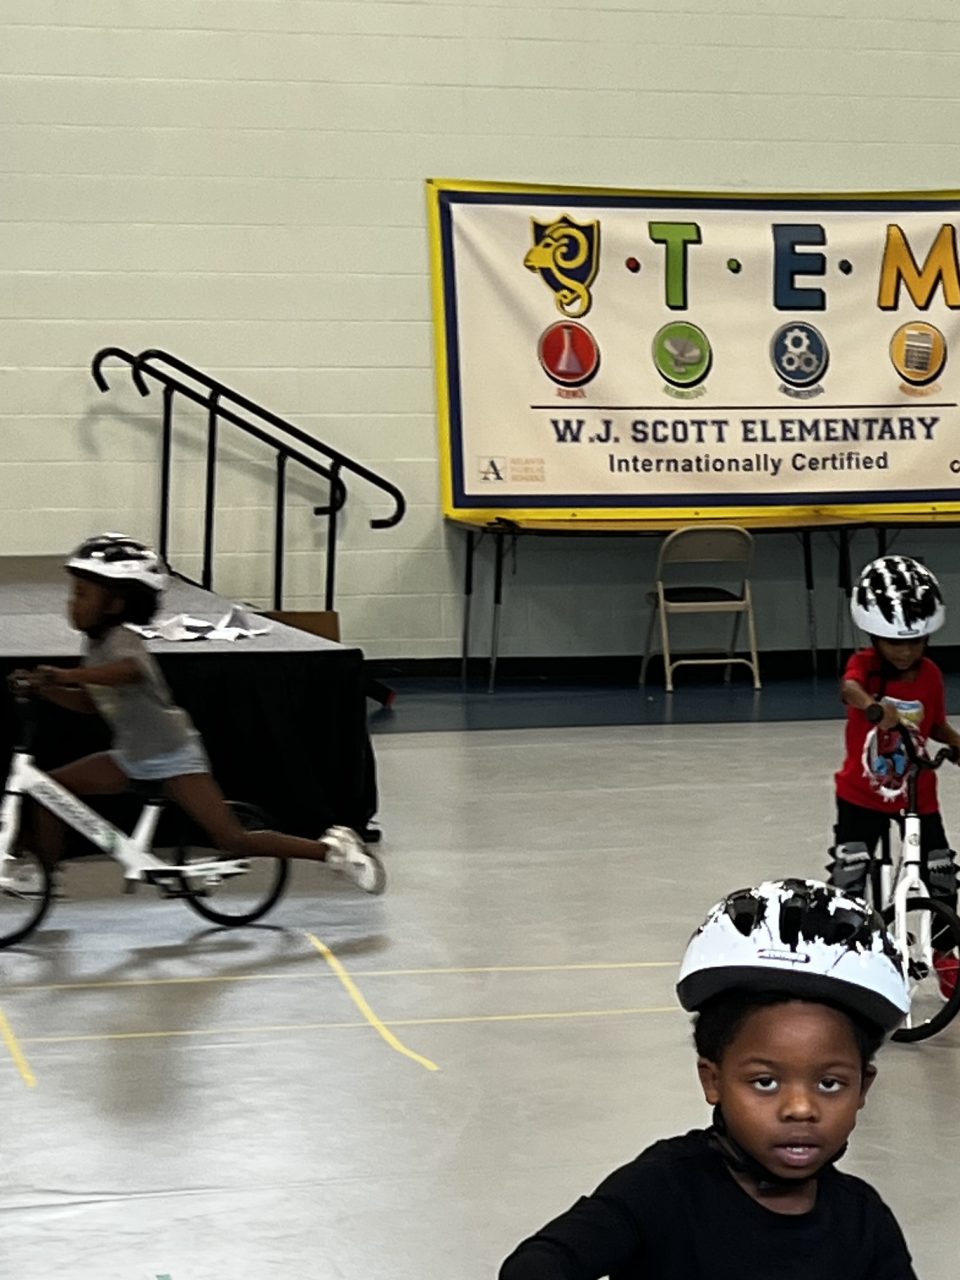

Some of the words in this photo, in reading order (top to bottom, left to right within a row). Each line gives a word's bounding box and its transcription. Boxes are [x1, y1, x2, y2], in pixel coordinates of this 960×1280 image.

[631, 419, 729, 443] SCOTT
[741, 417, 940, 442] ELEMENTARY
[609, 453, 783, 476] Internationally
[791, 451, 889, 471] Certified
